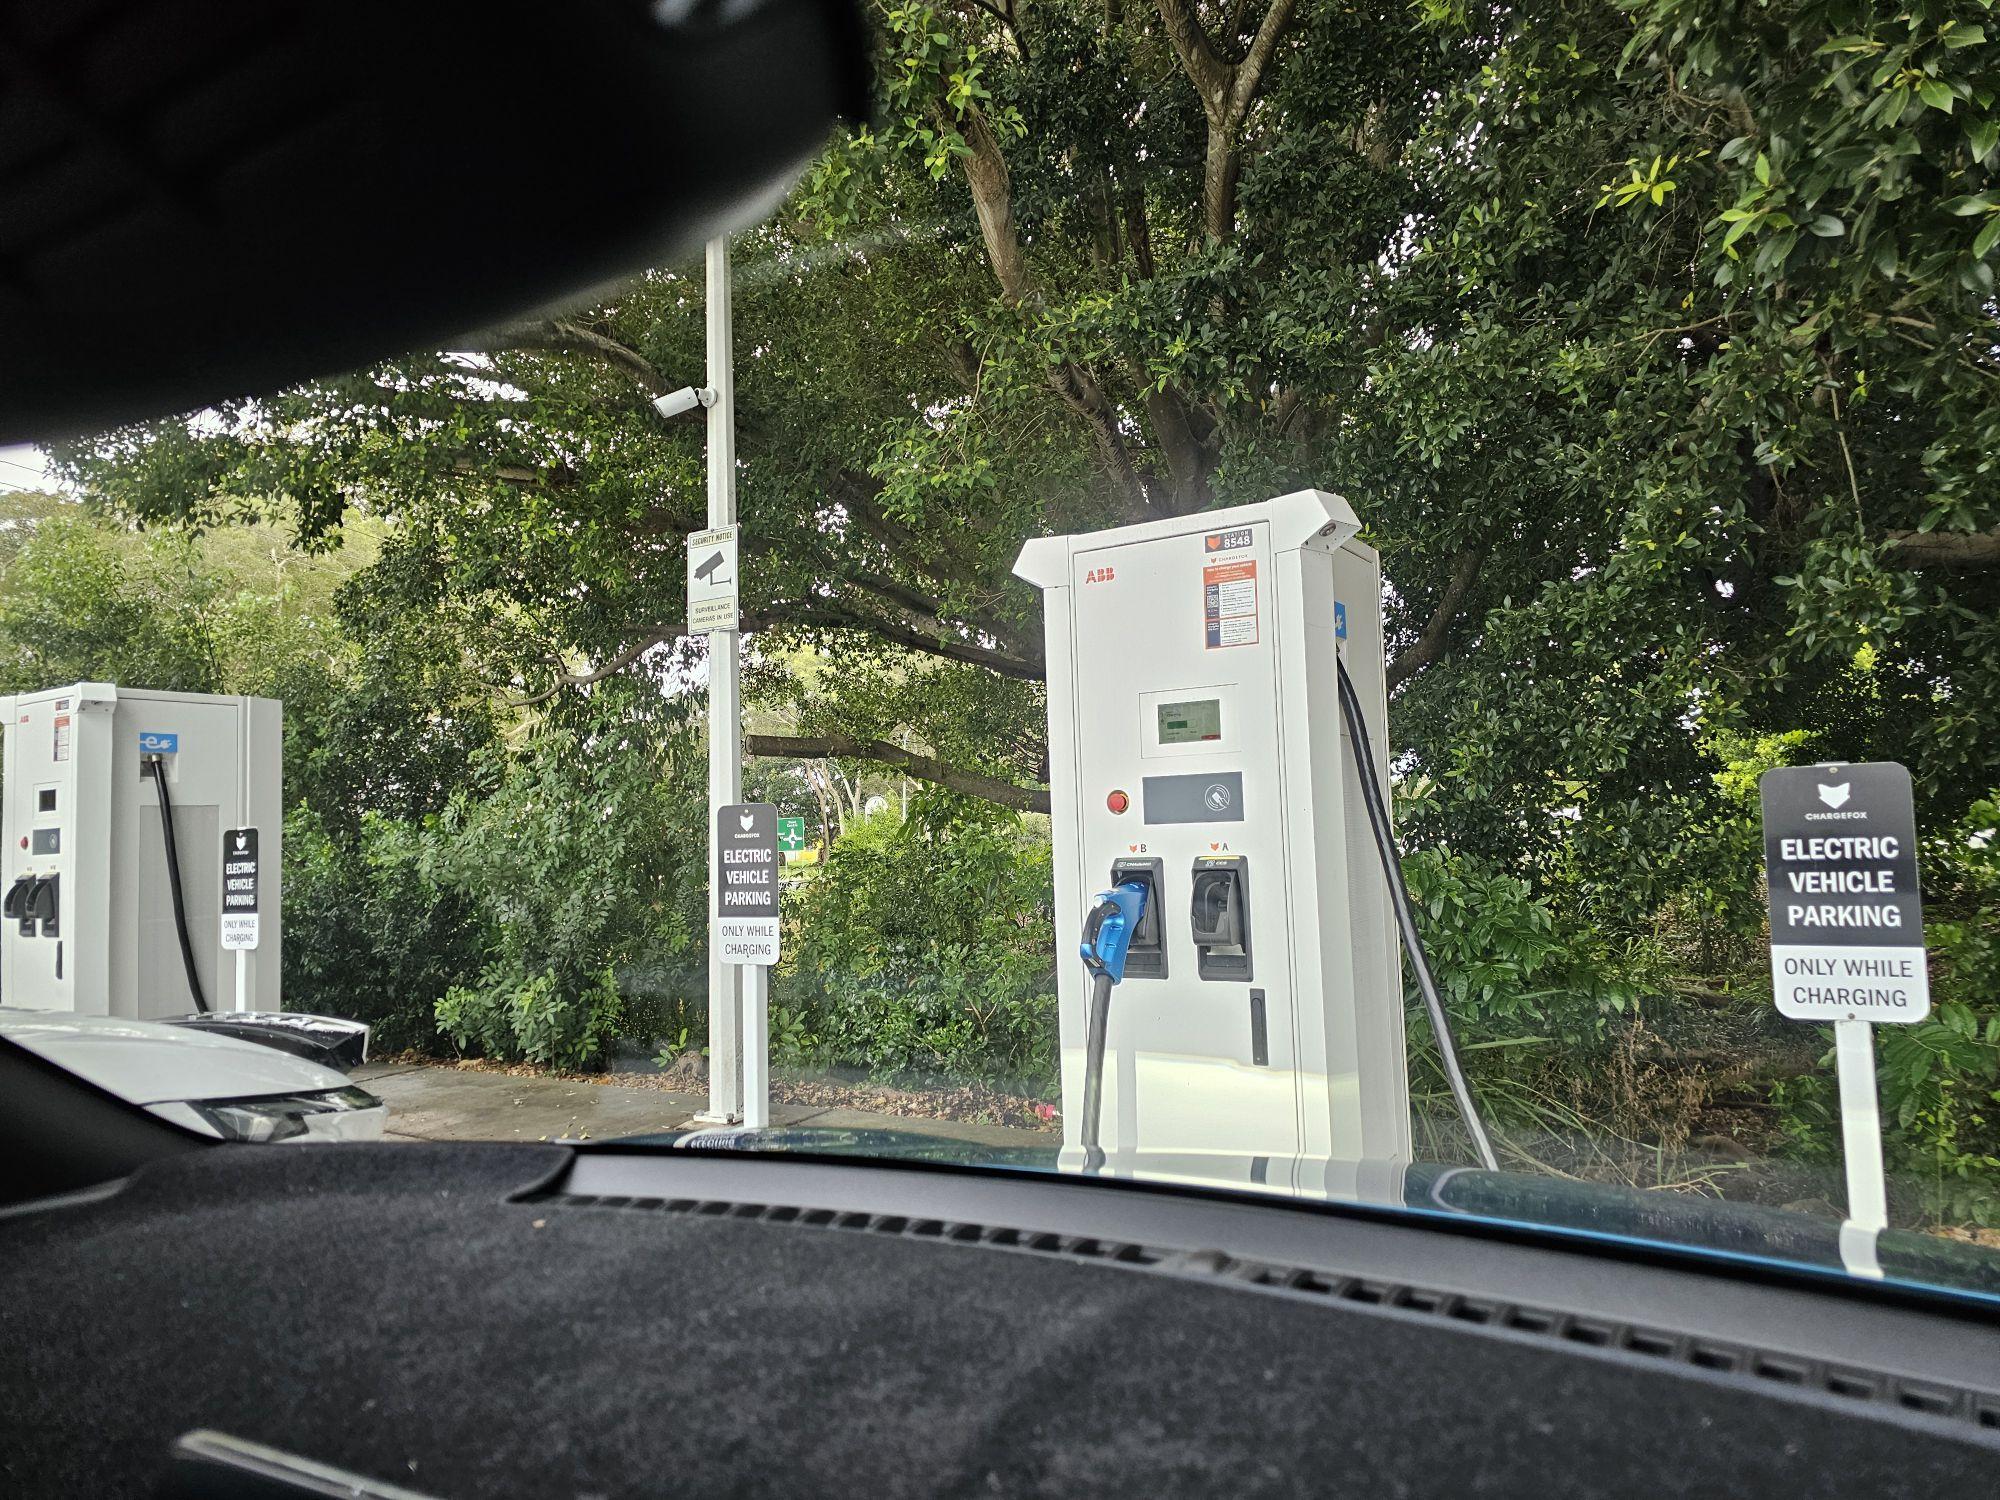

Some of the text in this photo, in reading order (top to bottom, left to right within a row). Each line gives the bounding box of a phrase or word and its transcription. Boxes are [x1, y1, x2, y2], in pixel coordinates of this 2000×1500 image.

[692, 531, 733, 546] SECURITY NOTICE
[1224, 536, 1251, 548] 8548
[1085, 567, 1115, 584] ABB
[695, 602, 731, 614] SURVEILLANCE
[692, 614, 715, 624] CAMERAS
[1805, 811, 1867, 820] CHARGEFOX
[1140, 844, 1147, 853] B
[1222, 843, 1229, 851] A
[1780, 836, 1899, 861] ELECTRIC
[723, 848, 772, 864] ELECTRIC
[226, 862, 256, 875] ELECTRIC
[726, 869, 770, 885] VEHICLE
[1788, 870, 1896, 894] VEHICLE
[227, 878, 254, 891] VEHICLE
[226, 894, 255, 906] PARKING
[724, 891, 771, 906] PARKING
[1787, 905, 1902, 928] PARKING
[224, 919, 256, 929] ONLY WHILE
[722, 925, 774, 937] ONLY WHILE
[225, 933, 254, 943] CHARGING
[725, 943, 771, 956] CHARGING
[1784, 957, 1914, 978] ONLY WHILE
[1793, 986, 1908, 1008] CHARGING
